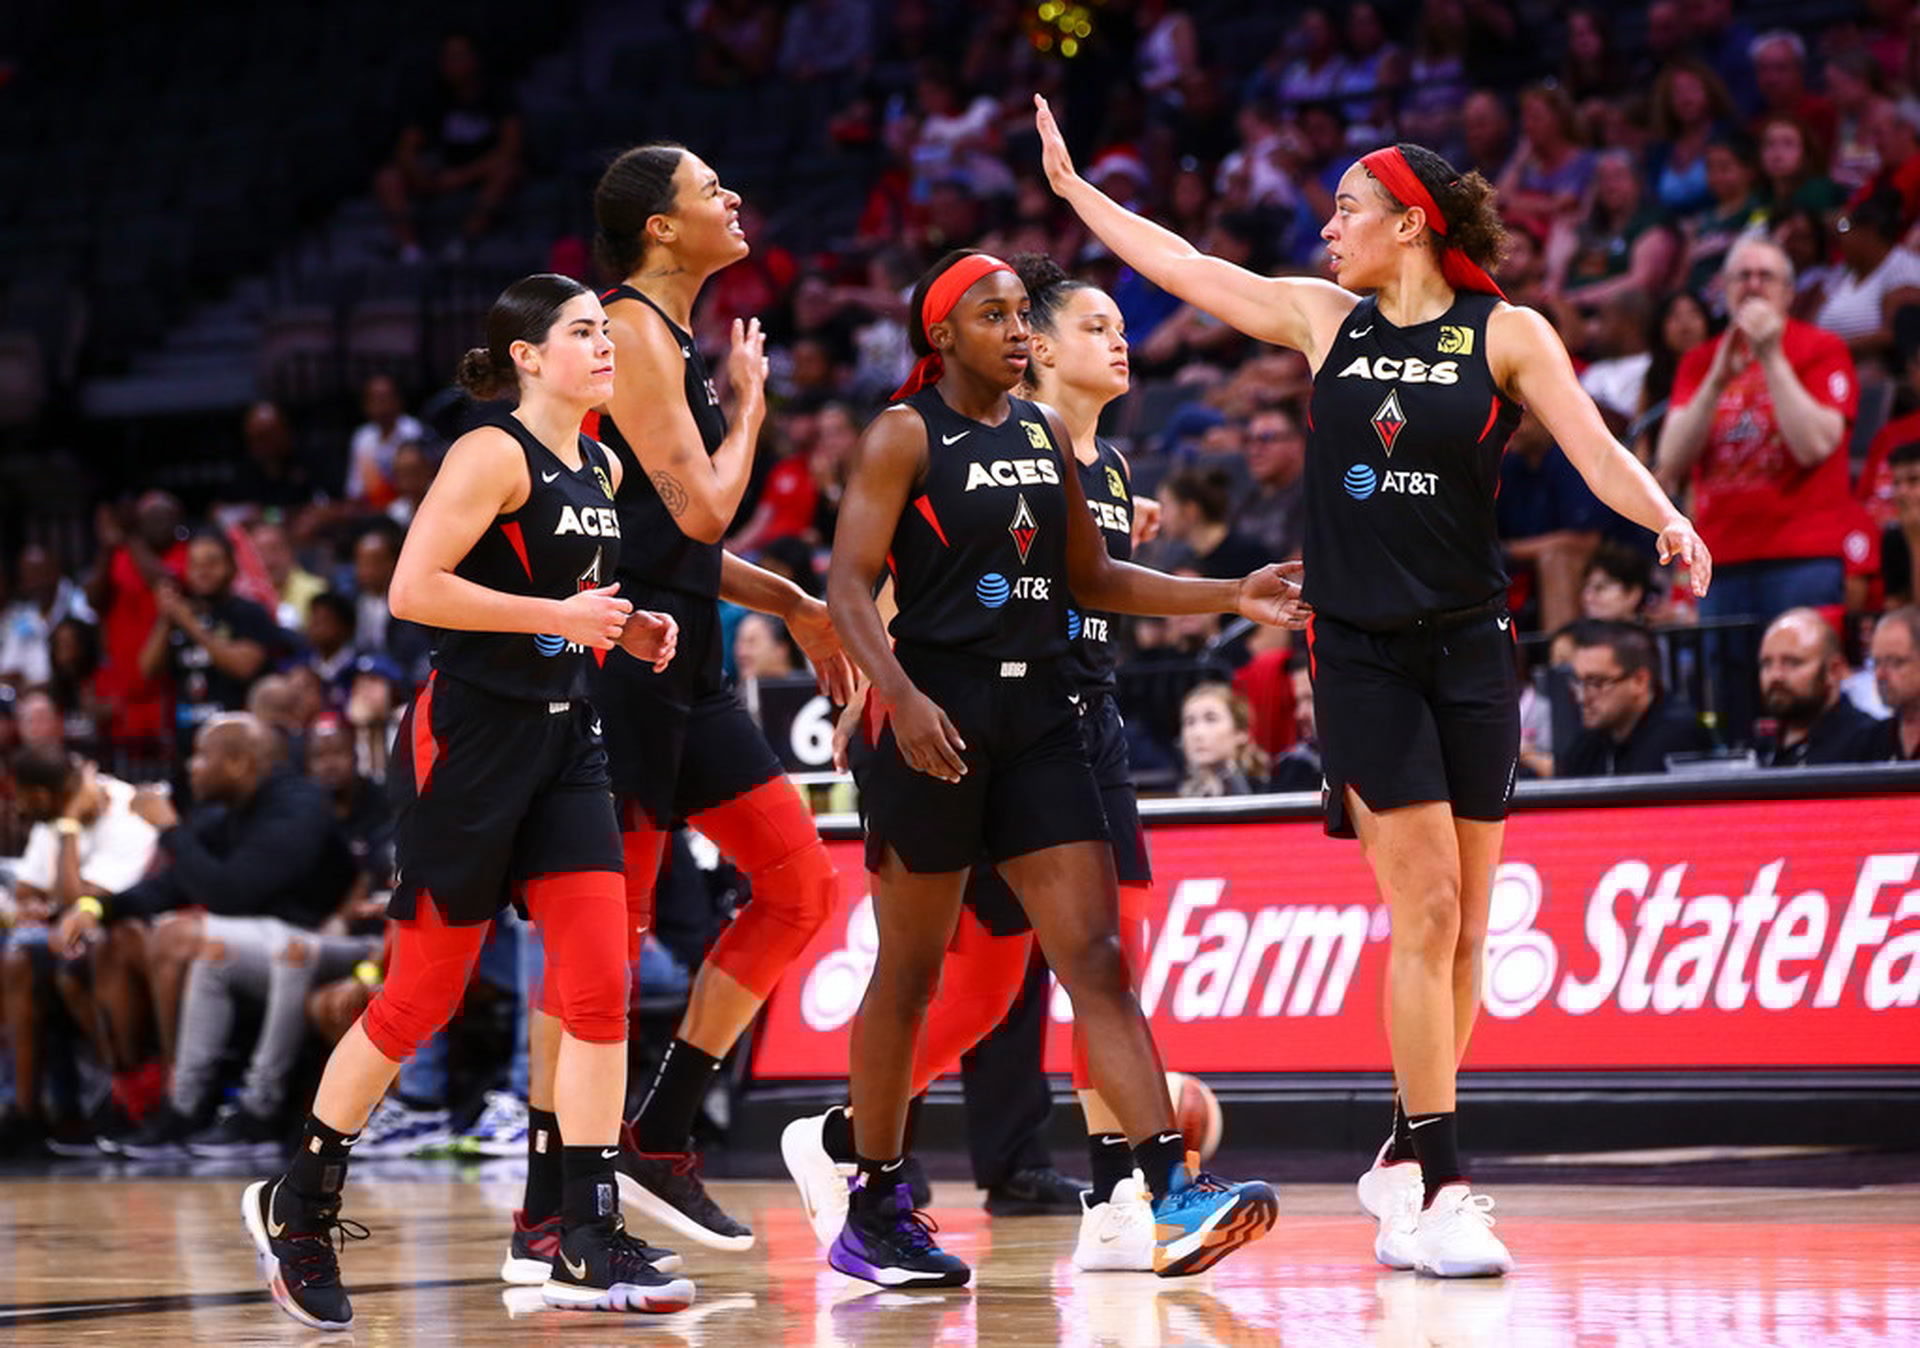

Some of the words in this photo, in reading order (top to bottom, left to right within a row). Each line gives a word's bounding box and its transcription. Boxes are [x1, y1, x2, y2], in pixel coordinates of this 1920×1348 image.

[1336, 355, 1460, 385] ACES
[963, 457, 1061, 492] ACES
[1380, 470, 1440, 496] AT&T
[1086, 499, 1131, 535] CES
[1009, 576, 1052, 601] AT&
[1082, 616, 1109, 643] AT&
[789, 695, 834, 766] 6
